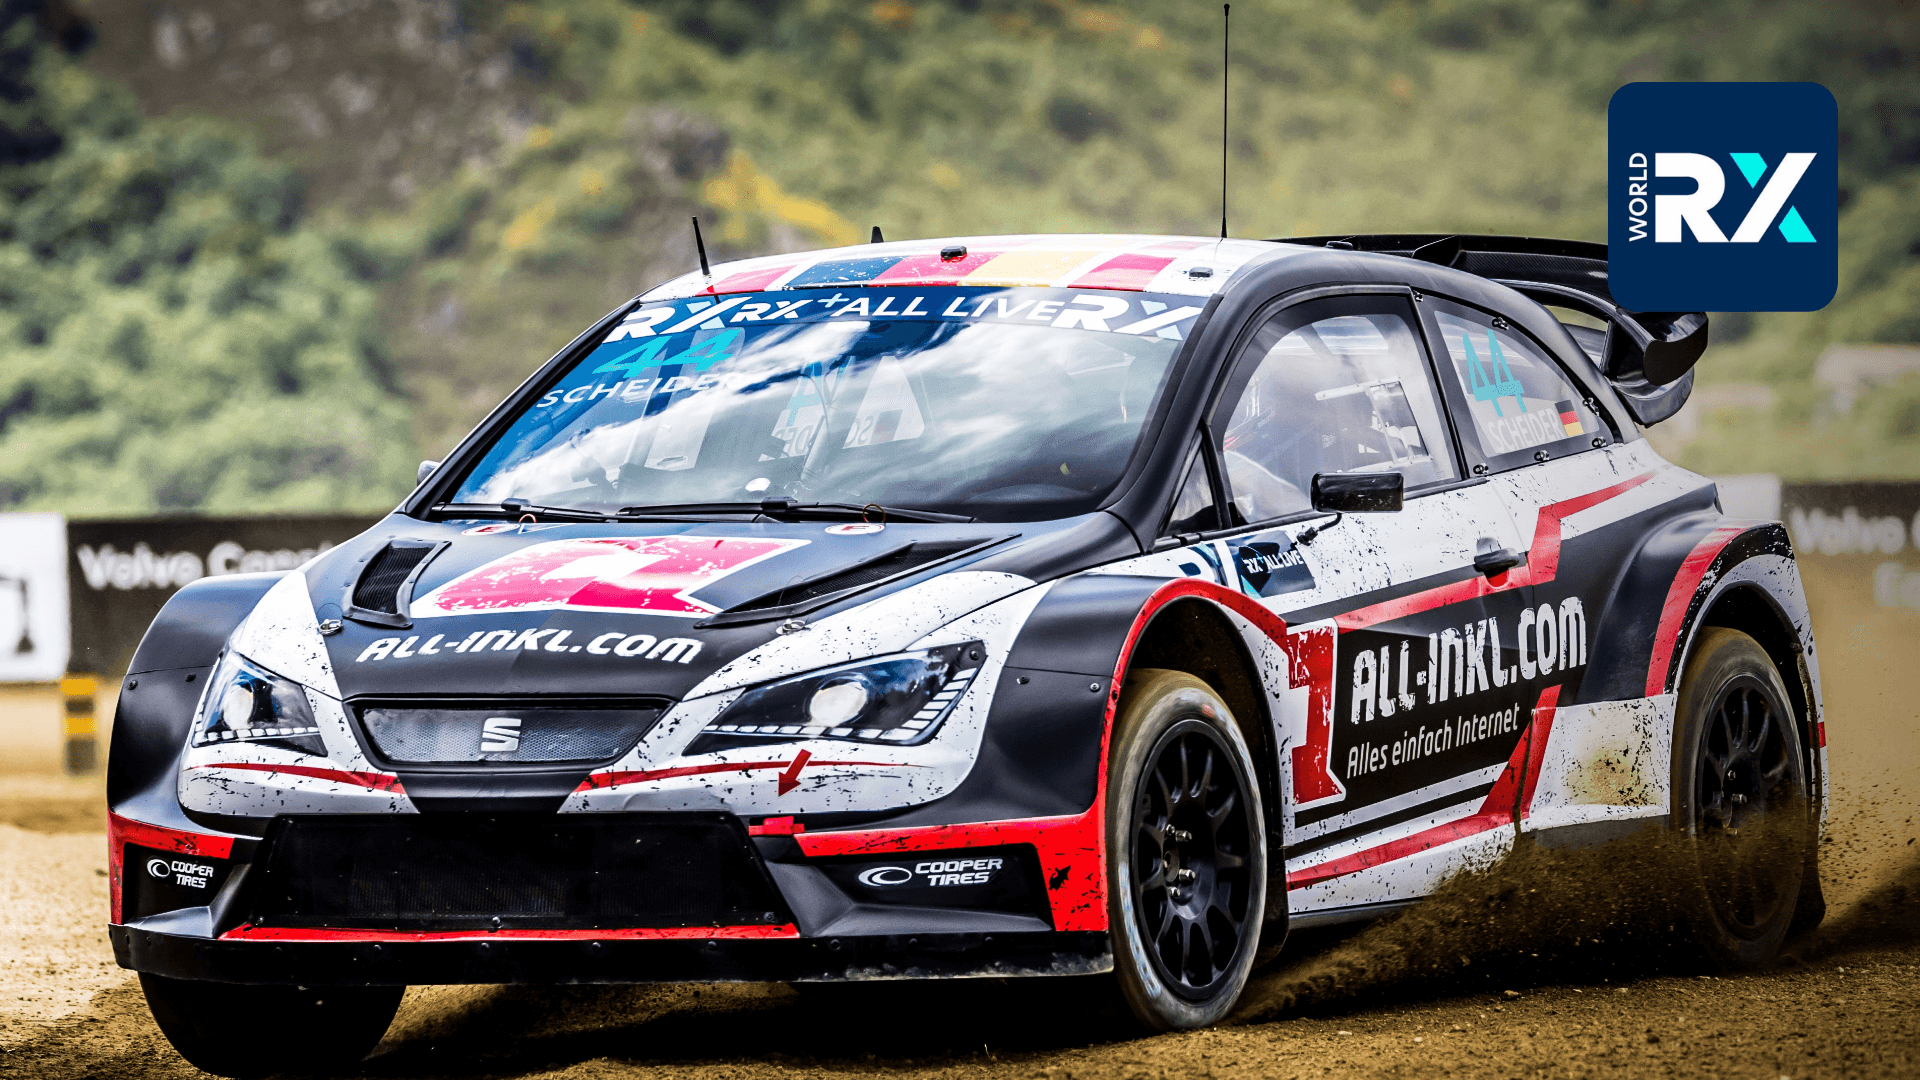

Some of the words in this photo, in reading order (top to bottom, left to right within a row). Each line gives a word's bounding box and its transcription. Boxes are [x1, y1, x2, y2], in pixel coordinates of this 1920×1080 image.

[602, 297, 753, 344] RX
[941, 296, 1066, 321] LIVE
[1050, 293, 1204, 341] RX
[592, 329, 742, 378] 44
[1463, 329, 1525, 417] 44
[536, 372, 747, 408] SCHEIDER
[1487, 408, 1565, 451] SCHEIDER
[77, 542, 203, 590] Volvo
[355, 627, 706, 664] ALL-INKL.COM
[1351, 596, 1588, 725] ALL-INKL.COM
[1347, 742, 1387, 779] Alles
[1392, 719, 1452, 765] einfach
[1456, 703, 1520, 748] Internet
[171, 861, 214, 877] COOPER
[176, 874, 207, 888] TIRES
[914, 858, 1004, 874] COOPER
[927, 871, 990, 886] TIRES
